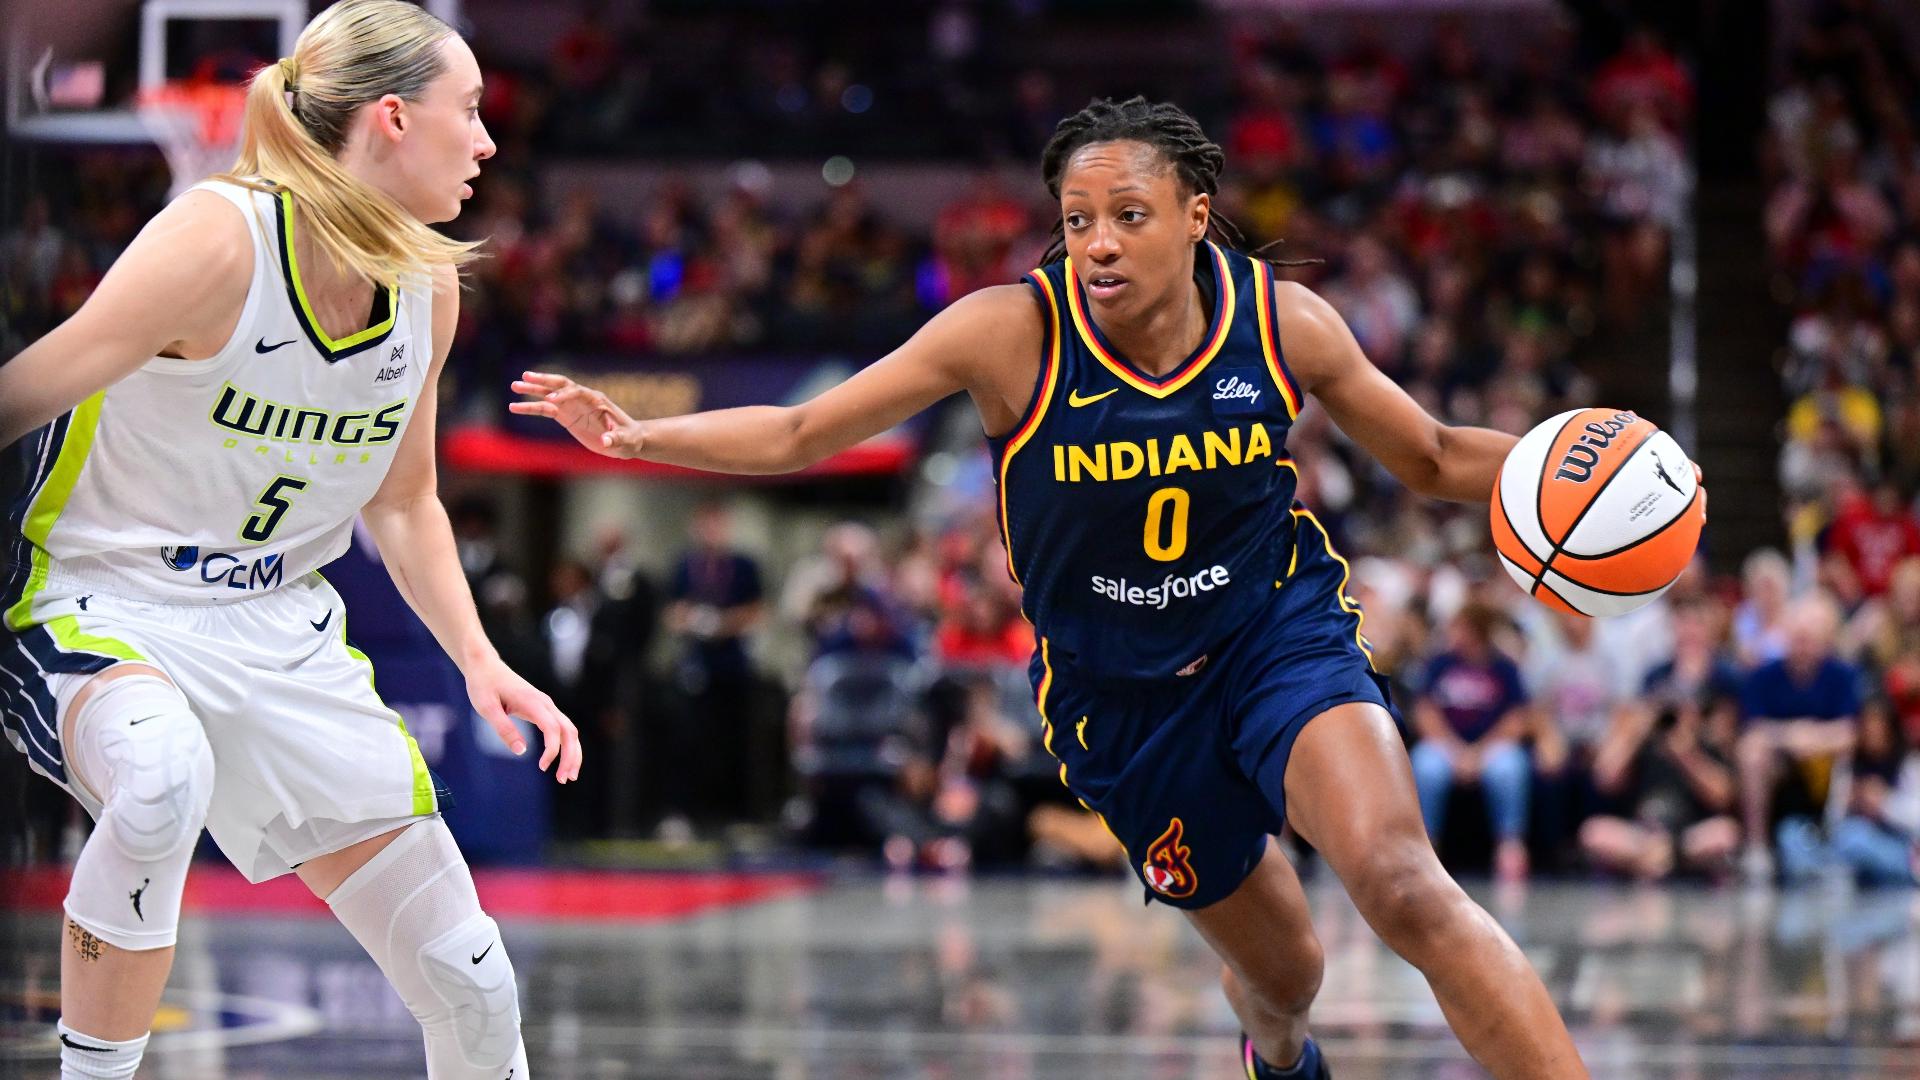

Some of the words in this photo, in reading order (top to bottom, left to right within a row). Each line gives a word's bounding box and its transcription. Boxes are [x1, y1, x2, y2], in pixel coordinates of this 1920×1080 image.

[374, 363, 407, 382] Albert
[1212, 376, 1261, 404] Lilly
[210, 380, 408, 447] WINGS
[223, 437, 373, 465] DALLAS
[1053, 423, 1272, 482] INDIANA
[238, 473, 312, 544] 5
[1143, 487, 1190, 562] 0
[1091, 564, 1230, 609] salesforce
